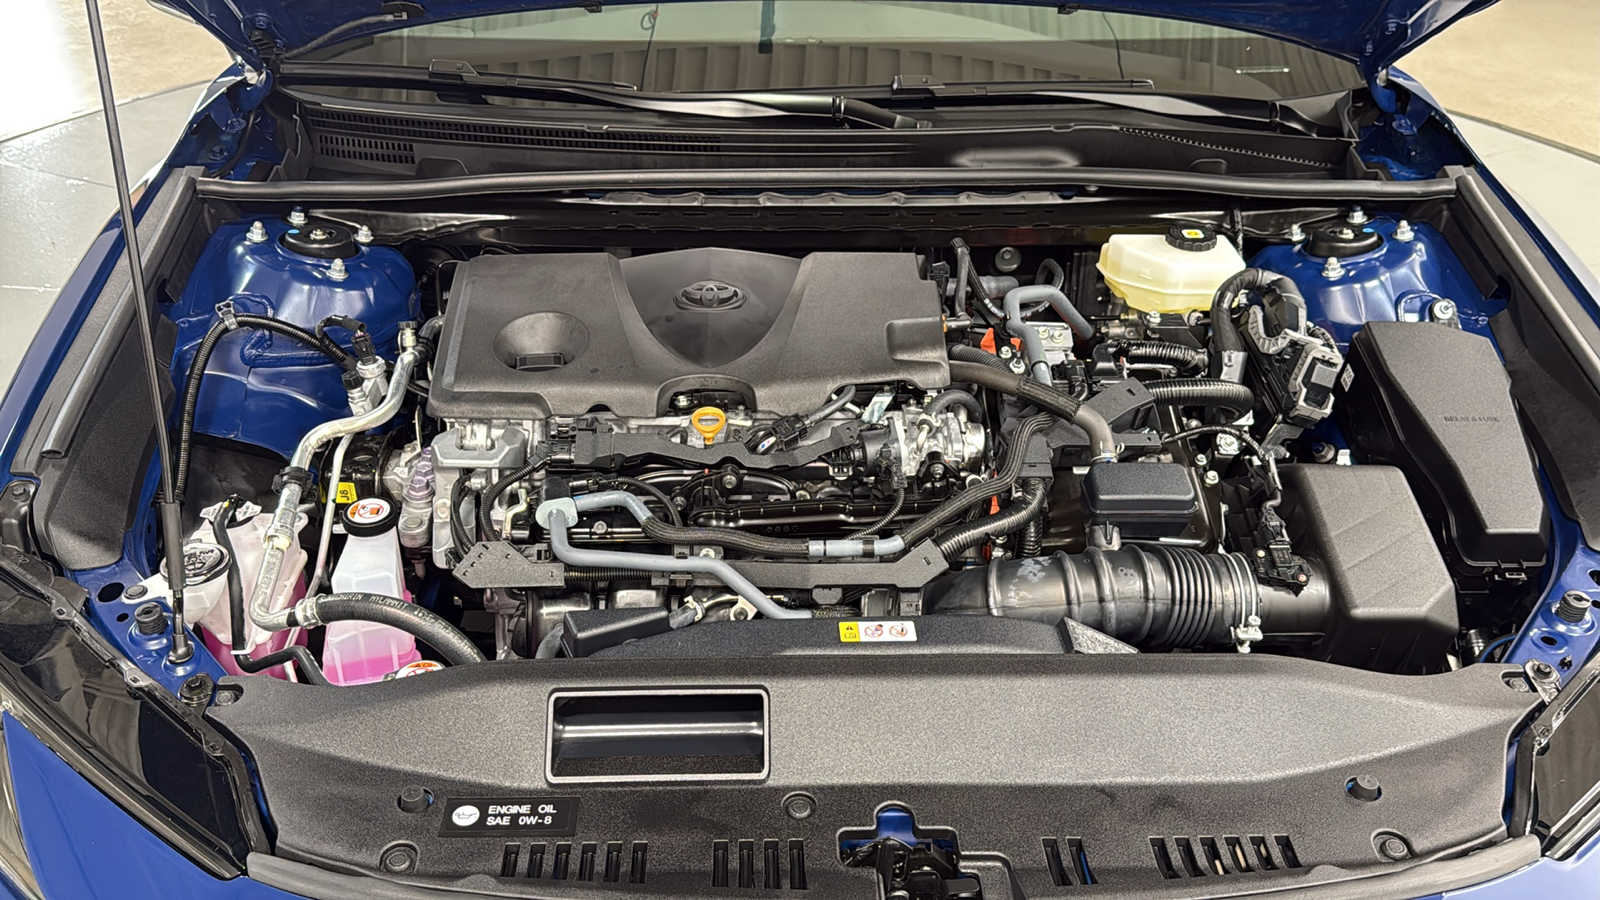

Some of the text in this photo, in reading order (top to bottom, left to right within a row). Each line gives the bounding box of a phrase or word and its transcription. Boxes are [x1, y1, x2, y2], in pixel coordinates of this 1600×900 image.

[339, 489, 350, 501] J8
[488, 804, 557, 814] ENGINE OIL
[486, 815, 552, 826] SAE 0W-8
